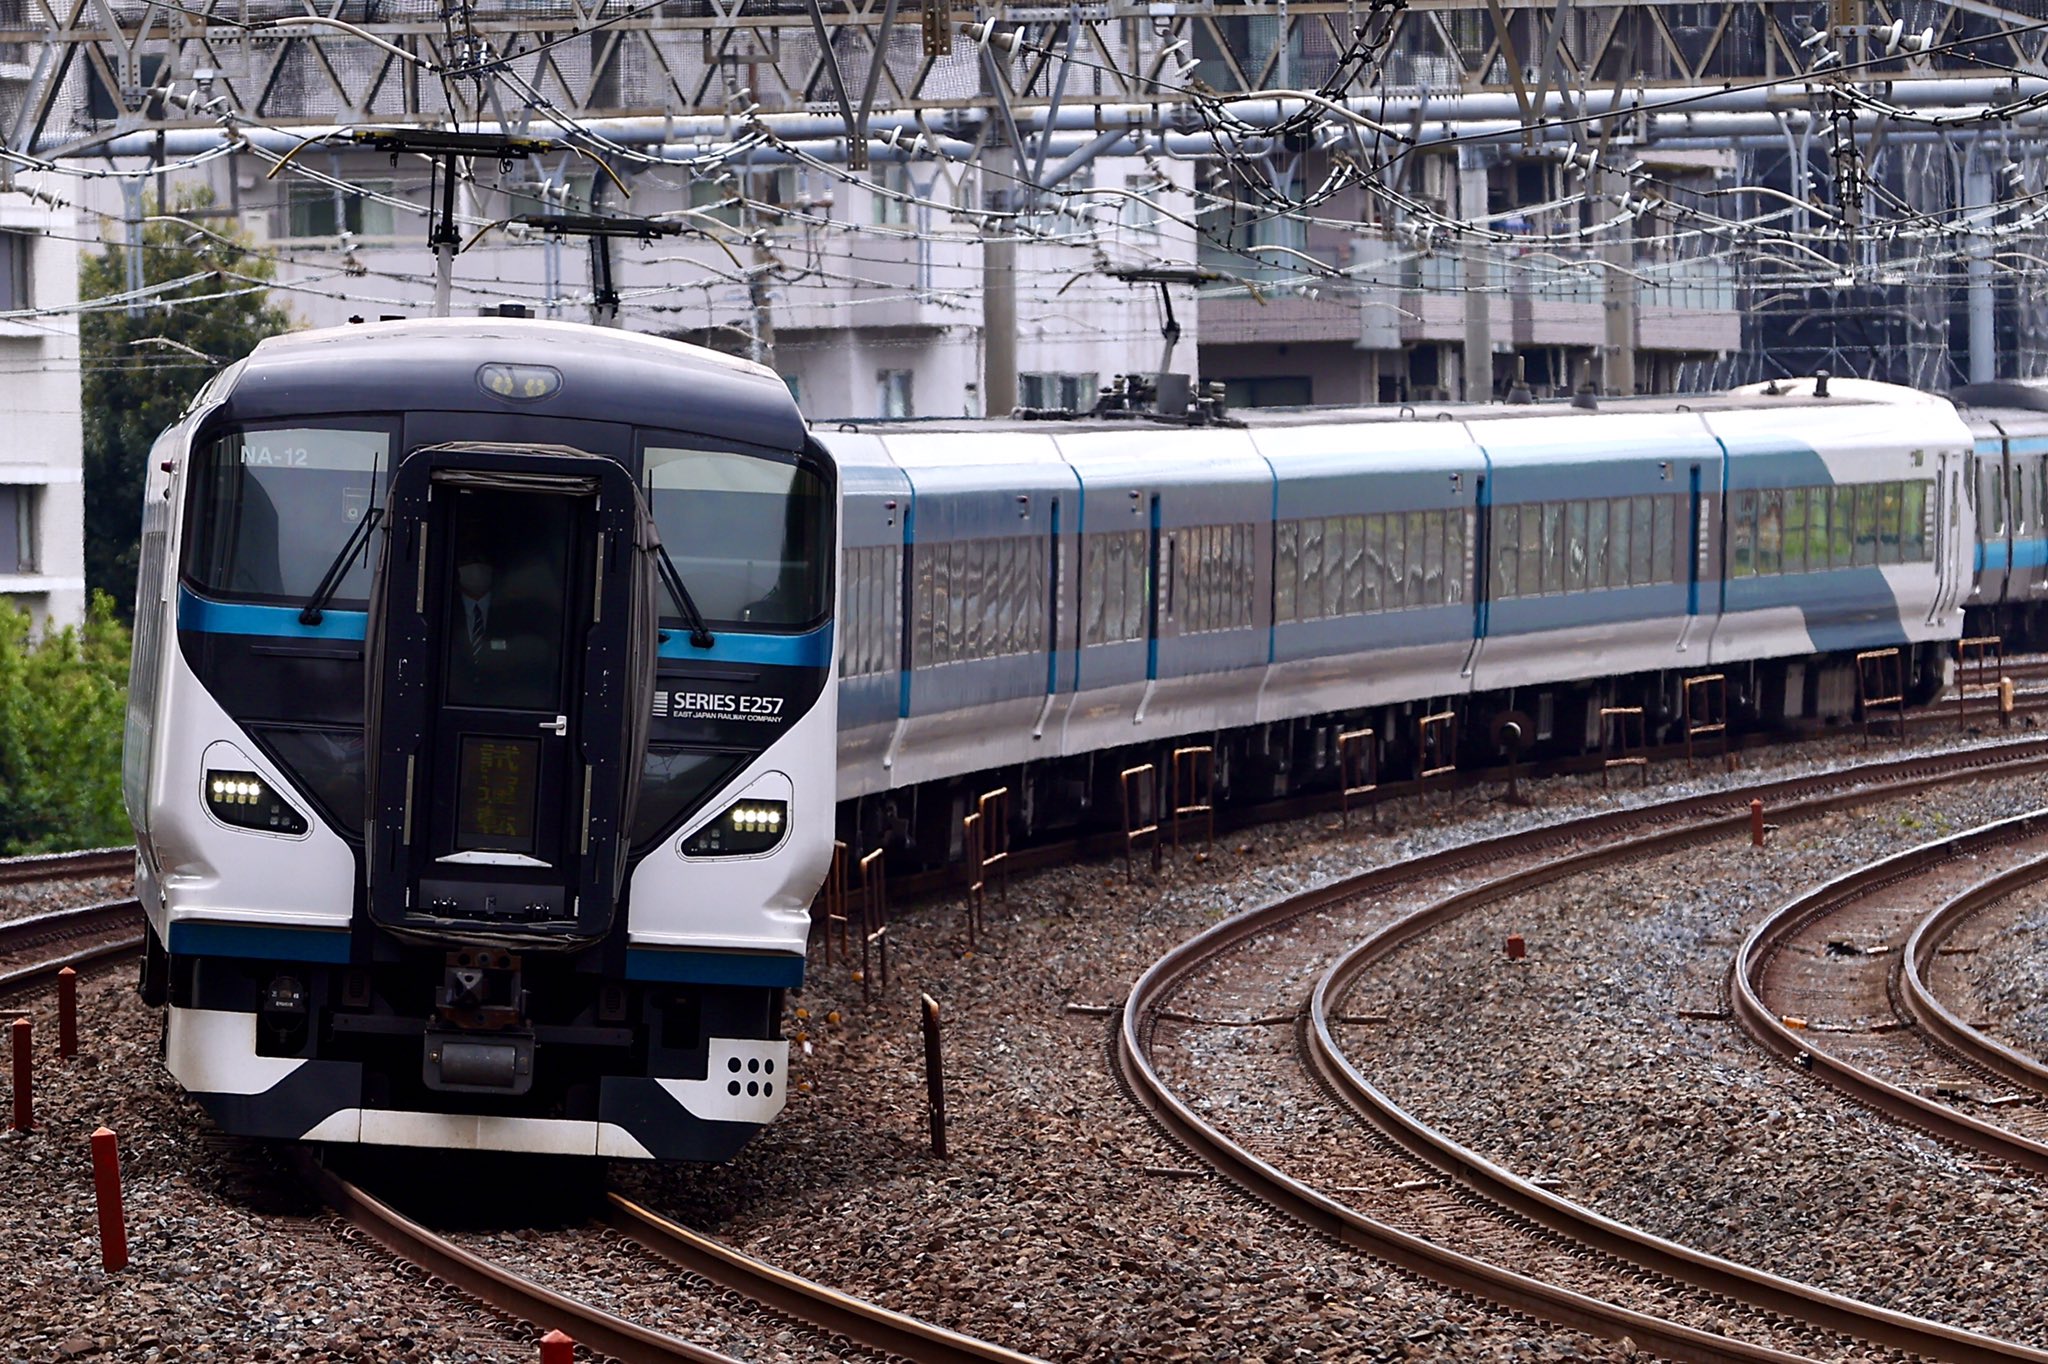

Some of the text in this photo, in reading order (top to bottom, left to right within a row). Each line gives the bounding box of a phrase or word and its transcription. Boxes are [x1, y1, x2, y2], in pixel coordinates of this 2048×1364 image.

[240, 445, 308, 466] NA-12
[673, 692, 784, 714] SERIES E257
[747, 715, 783, 723] COMPANY
